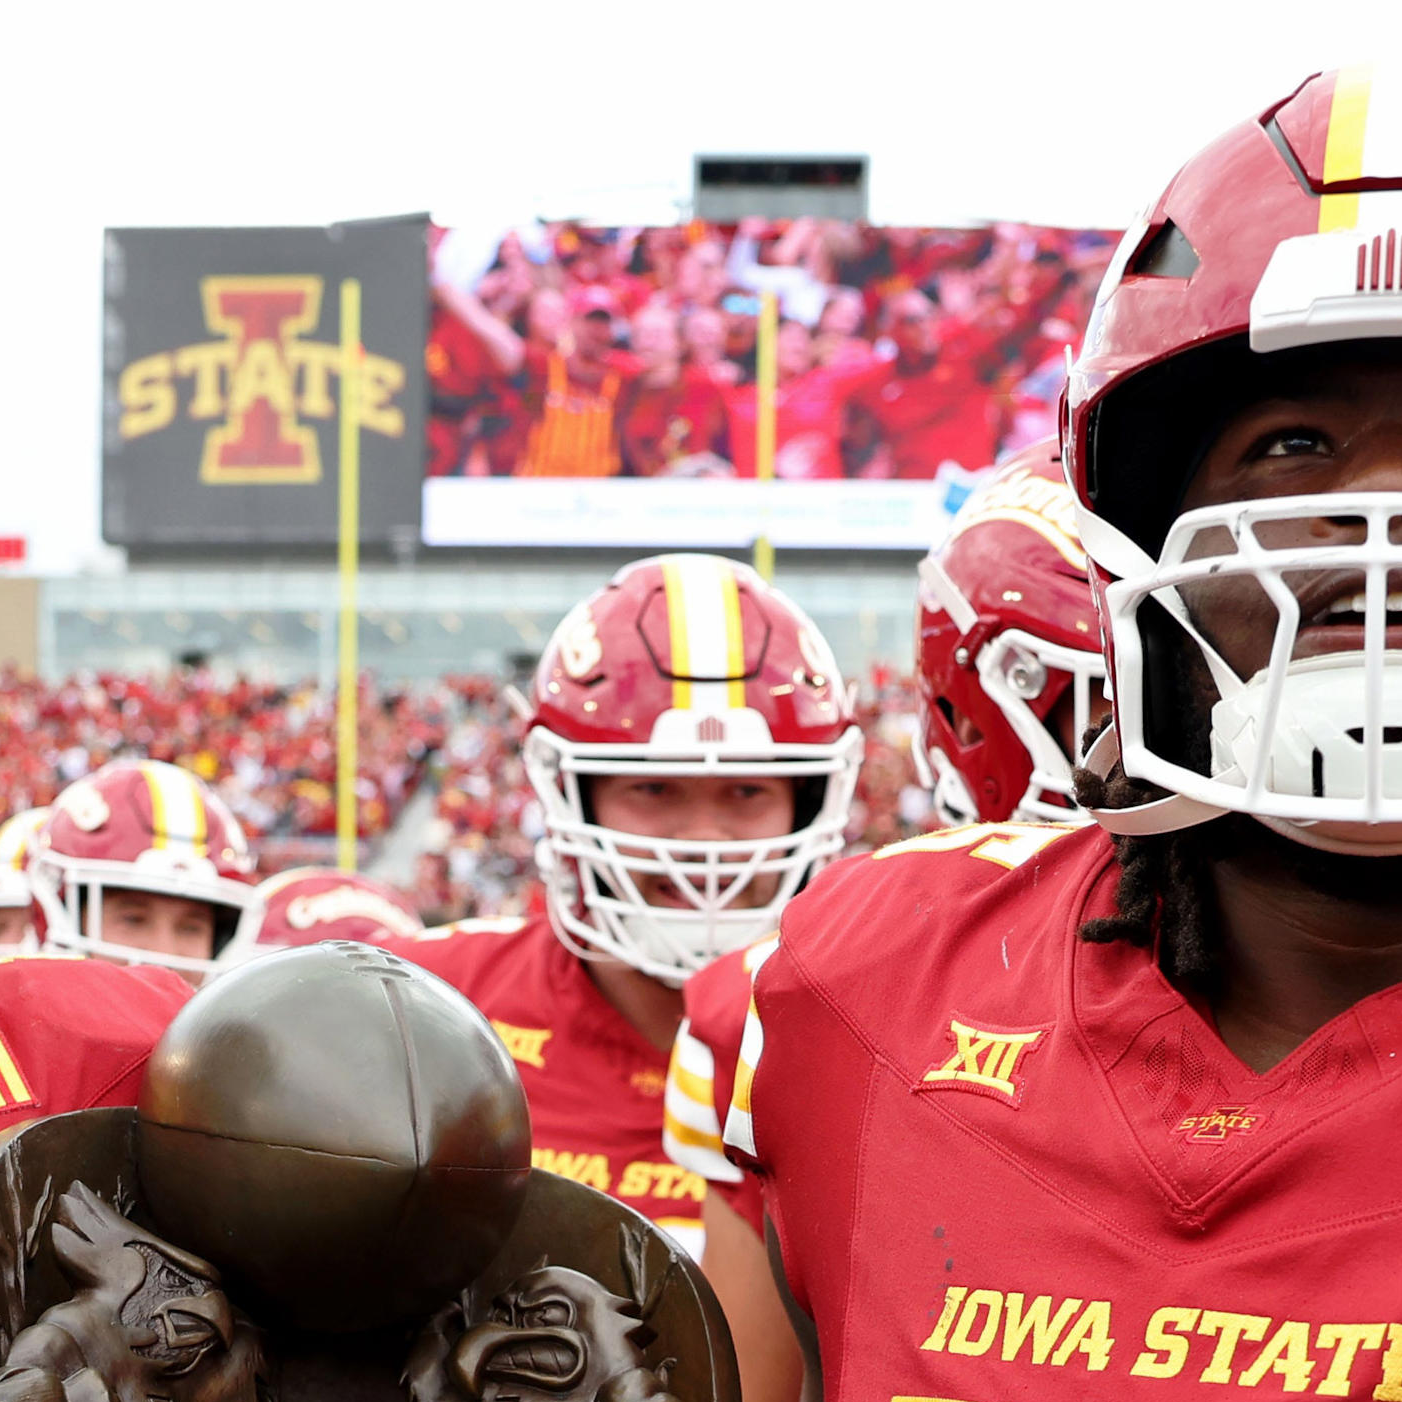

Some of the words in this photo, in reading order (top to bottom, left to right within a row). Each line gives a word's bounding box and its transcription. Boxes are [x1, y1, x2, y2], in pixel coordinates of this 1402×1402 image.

[119, 339, 406, 439] STATE
[1178, 1112, 1257, 1130] STATE
[921, 1285, 1114, 1371] IOWA
